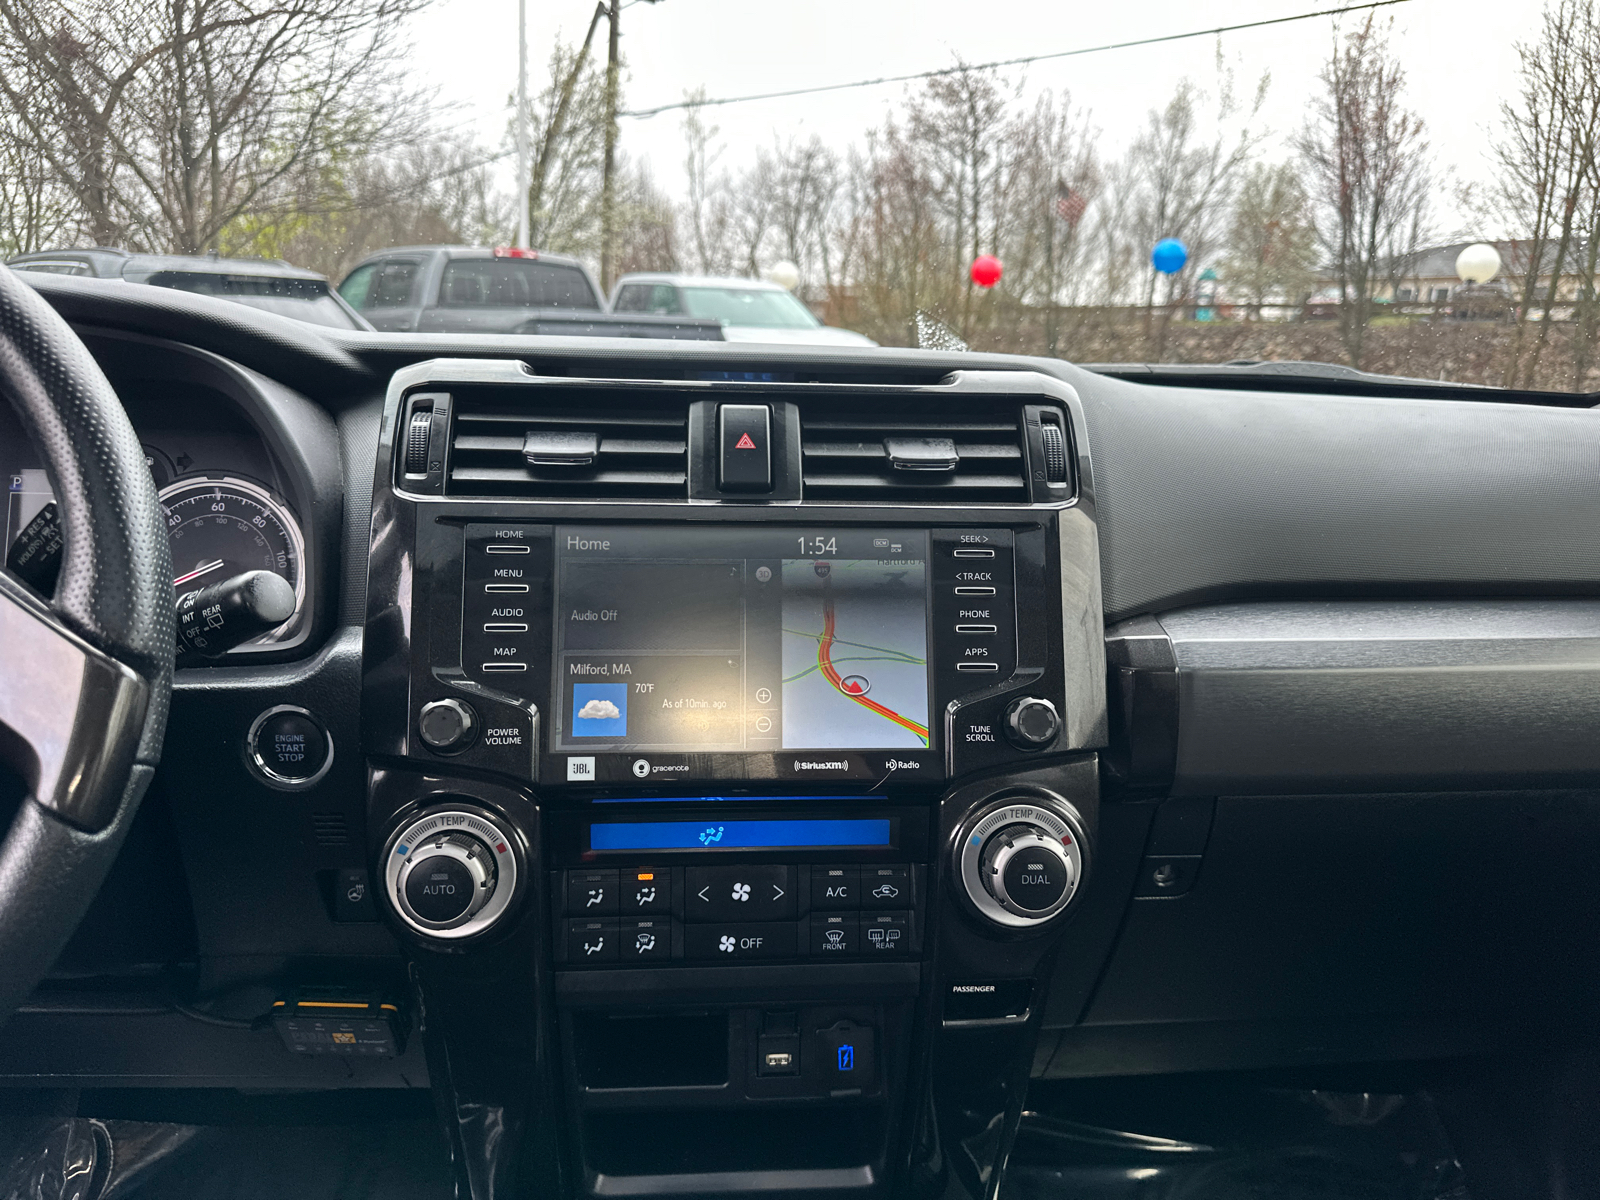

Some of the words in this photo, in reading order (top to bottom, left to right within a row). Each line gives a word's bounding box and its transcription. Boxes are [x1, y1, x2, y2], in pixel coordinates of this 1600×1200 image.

[12, 476, 22, 488] P
[211, 502, 226, 512] 60
[168, 514, 182, 527] 40
[252, 515, 267, 529] 80
[27, 517, 46, 537] RES
[236, 522, 249, 533] 120
[495, 530, 524, 539] HOME
[960, 534, 981, 544] SEEK
[46, 535, 64, 554] SET
[566, 536, 611, 552] Home
[797, 536, 838, 555] 1:54
[276, 549, 288, 569] 100
[494, 568, 523, 577] MENU
[758, 568, 770, 579] 3D
[962, 571, 992, 581] TRACK
[202, 604, 221, 618] REAR
[491, 607, 524, 617] AUDIO
[571, 609, 598, 621] Audio
[600, 609, 618, 621] Off
[959, 609, 990, 619] PHONE
[182, 611, 195, 624] INT
[186, 626, 201, 639] OFF
[493, 647, 517, 656] MAP
[964, 647, 988, 657] APPS
[570, 663, 610, 676] Milford,
[612, 664, 632, 676] MA
[662, 698, 672, 709] As
[674, 698, 683, 709] of
[685, 698, 711, 709] 10min.
[712, 699, 727, 711] ago
[487, 727, 519, 737] POWER
[970, 725, 991, 735] TUNE
[275, 734, 305, 743] ENGINE
[485, 736, 522, 746] VOLUME
[966, 734, 995, 743] SCROLL
[275, 743, 305, 753] START
[278, 752, 305, 763] STOP
[573, 763, 590, 775] JBL
[652, 764, 690, 773] gracenote
[898, 760, 920, 769] Radio
[1009, 809, 1034, 819] TEMP
[440, 816, 466, 827] TEMP
[1021, 874, 1051, 886] DUAL
[423, 884, 456, 896] AUTO
[826, 886, 848, 899] A/C
[740, 938, 764, 951] OFF
[822, 943, 847, 951] FRONT
[875, 941, 896, 950] REAR
[952, 985, 996, 994] PASSENGER
